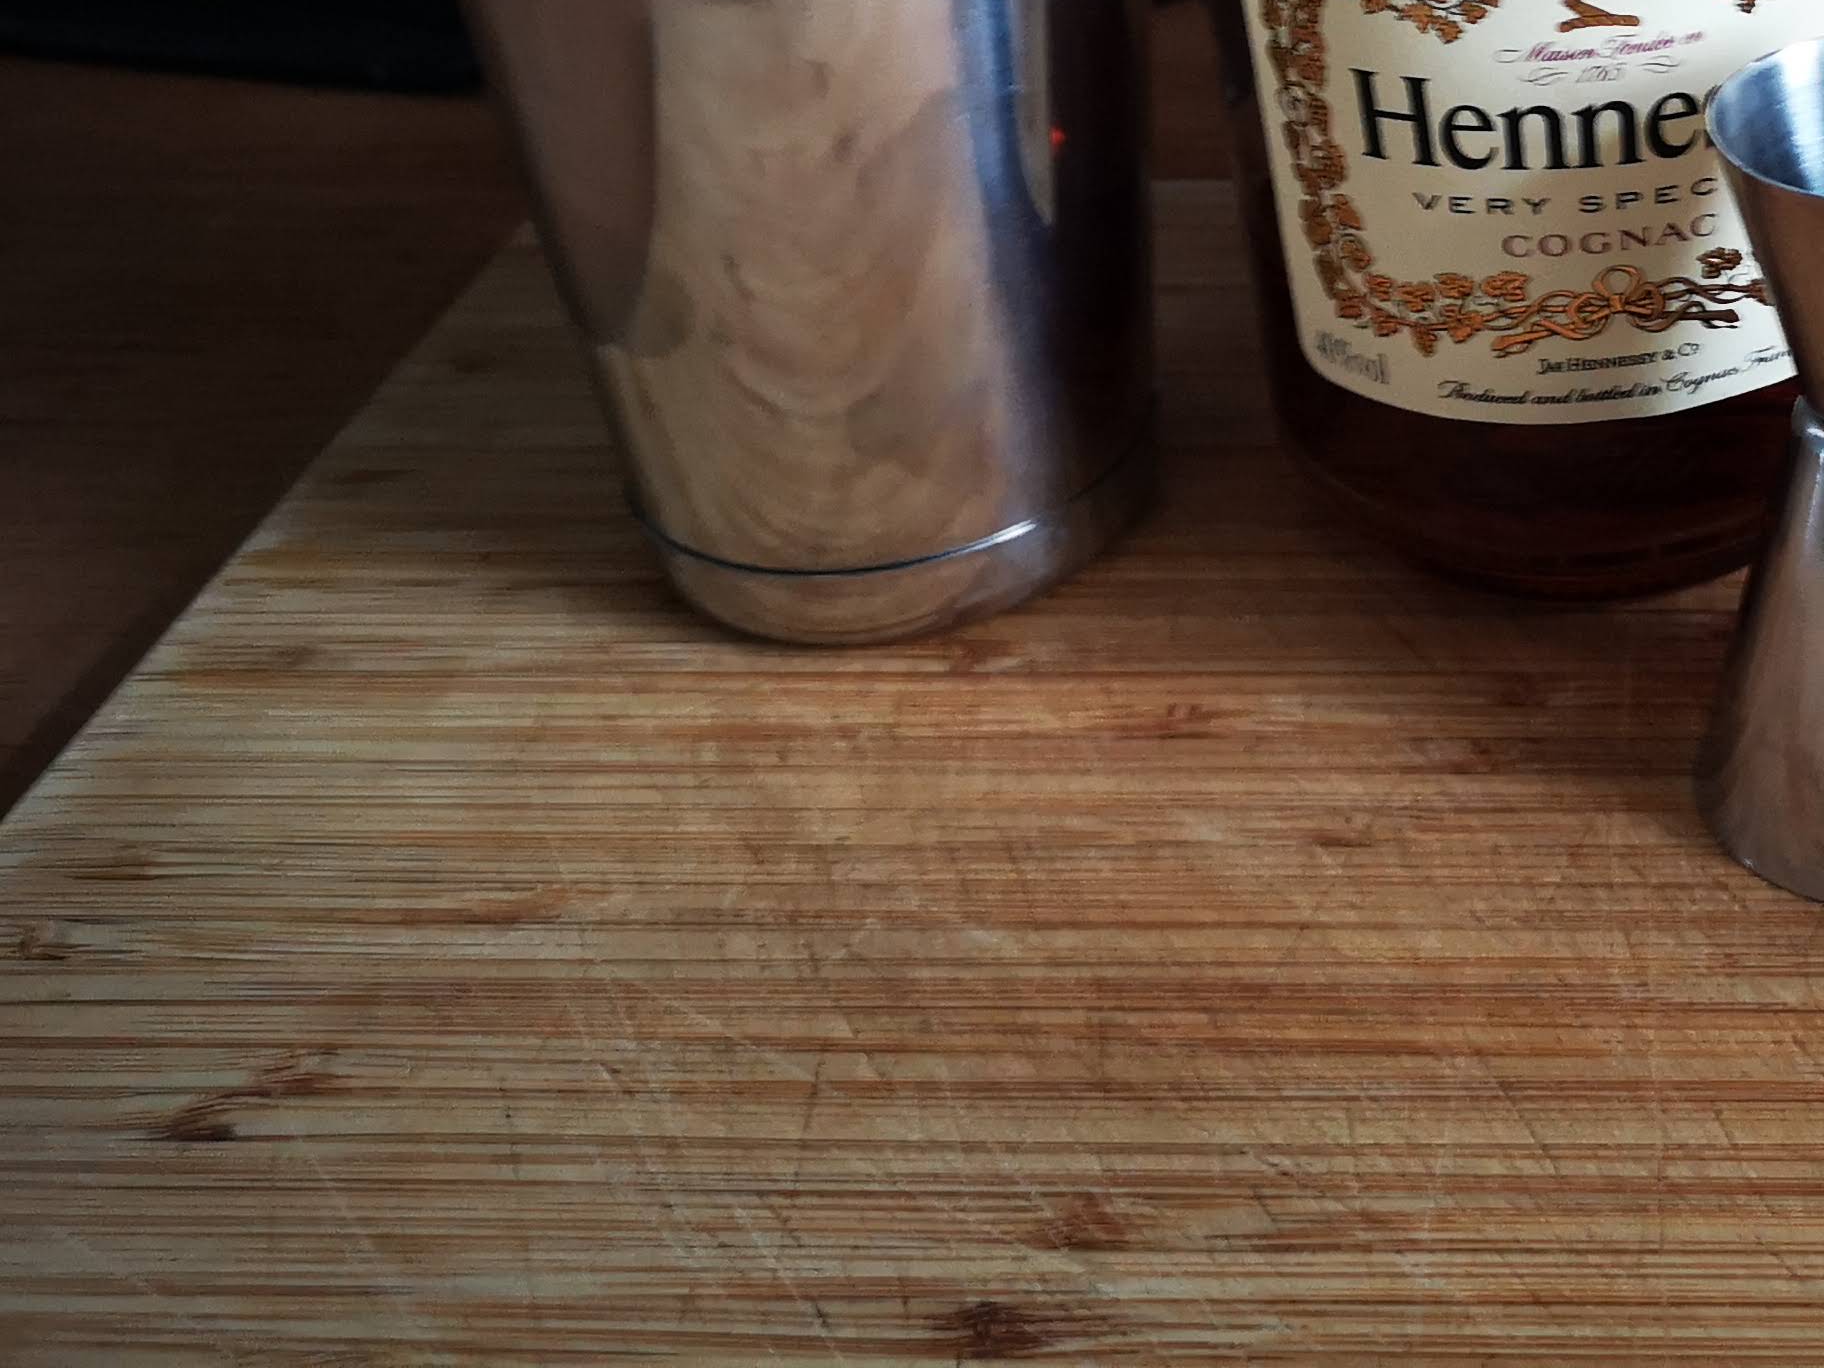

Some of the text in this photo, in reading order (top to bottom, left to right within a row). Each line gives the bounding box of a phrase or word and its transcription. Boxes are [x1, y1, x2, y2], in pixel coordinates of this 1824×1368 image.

[1349, 68, 1720, 171] Henne
[1410, 176, 1719, 215] VERY SPEC
[1500, 212, 1719, 259] COGNAC
[1531, 388, 1575, 405] and
